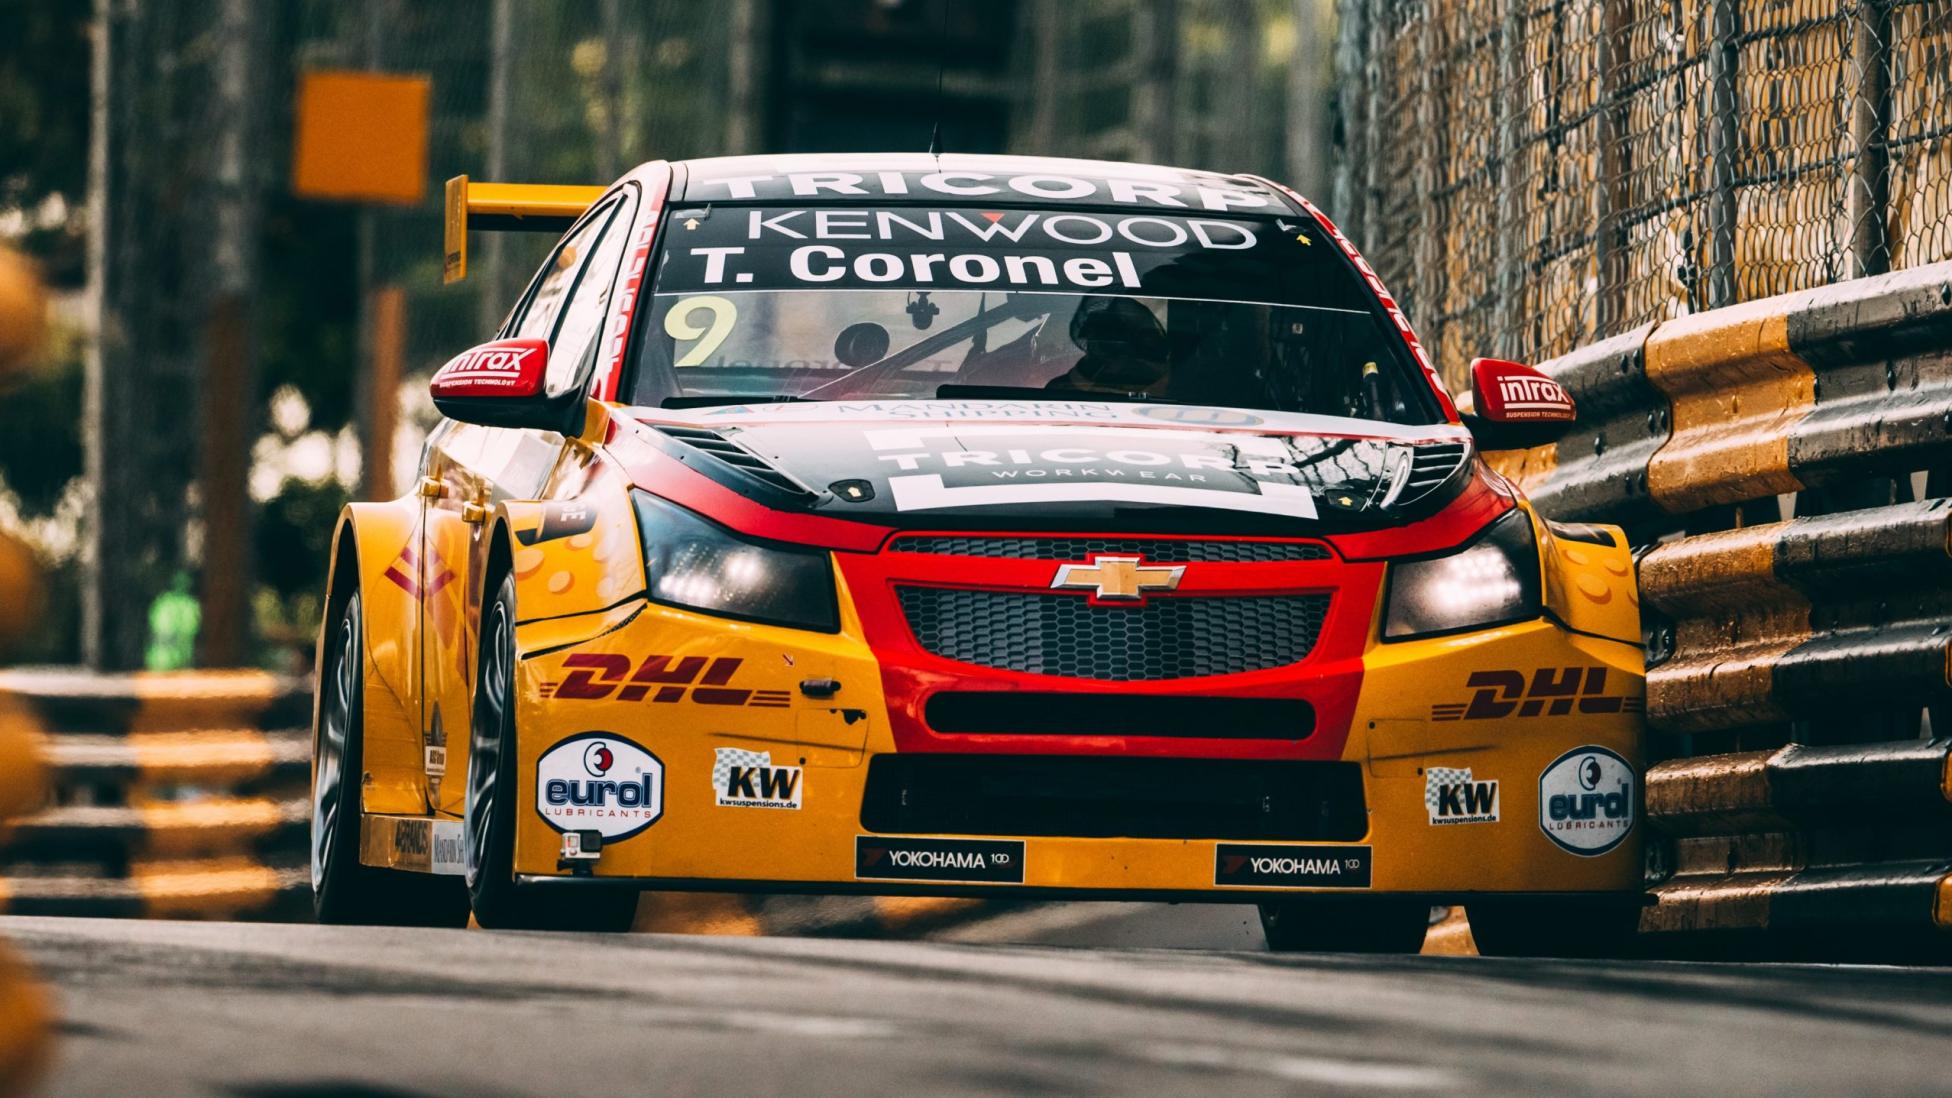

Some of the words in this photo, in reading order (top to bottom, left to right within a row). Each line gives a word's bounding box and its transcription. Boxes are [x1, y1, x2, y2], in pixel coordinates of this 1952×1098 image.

[703, 171, 1269, 211] TRICORP
[748, 210, 1258, 250] KENWOOD
[690, 246, 754, 284] T.
[790, 245, 1142, 288] Coronel
[664, 295, 738, 367] 9
[877, 448, 1300, 475] TRICORP
[991, 468, 1207, 482] WORKWEAR
[553, 653, 753, 706] DHL
[1464, 667, 1626, 721] DHL
[545, 772, 653, 808] eurol
[727, 766, 801, 800] KW
[1438, 782, 1498, 816] KW
[545, 807, 652, 819] LUBRICANTS
[719, 798, 798, 809] kwsuspensions.de
[1548, 783, 1629, 821] eurol
[1549, 819, 1629, 831] LUBRICANTS
[889, 850, 986, 869] YOKOHAMA
[1250, 857, 1341, 875] YOKOHAMA
